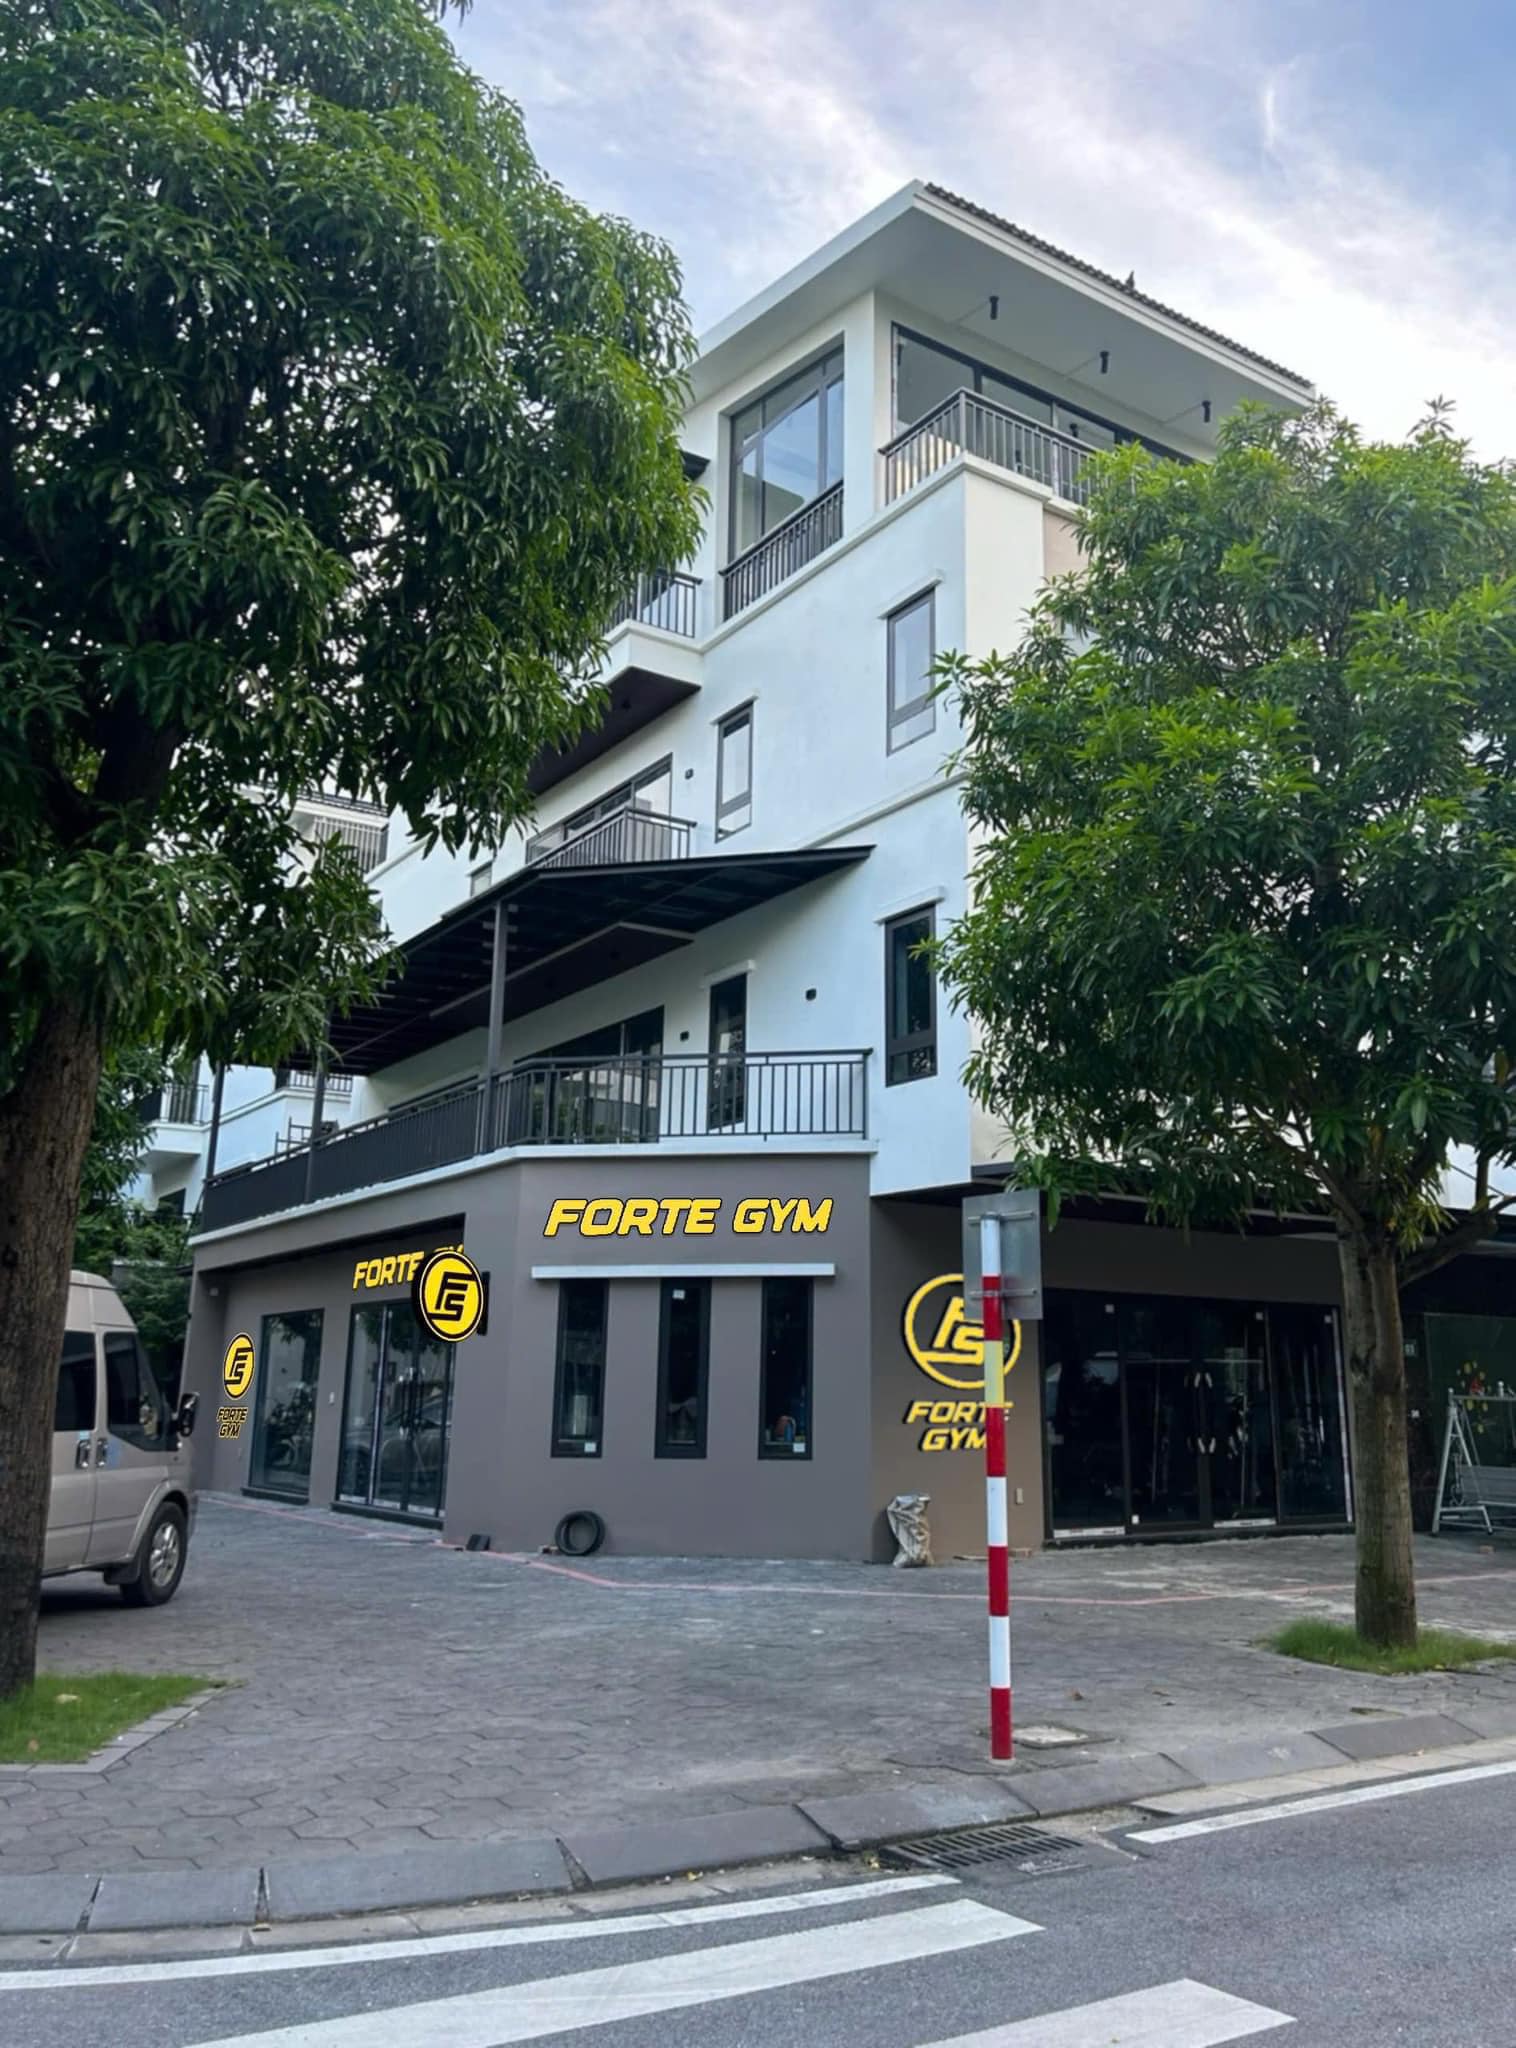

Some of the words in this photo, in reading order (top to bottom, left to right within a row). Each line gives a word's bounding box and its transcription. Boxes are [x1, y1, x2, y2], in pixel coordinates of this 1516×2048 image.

[543, 1198, 721, 1236] FORTE
[732, 1198, 833, 1233] GYM
[353, 1251, 425, 1290] FORTE
[216, 1407, 248, 1422] FORTE
[219, 1423, 241, 1439] GYM
